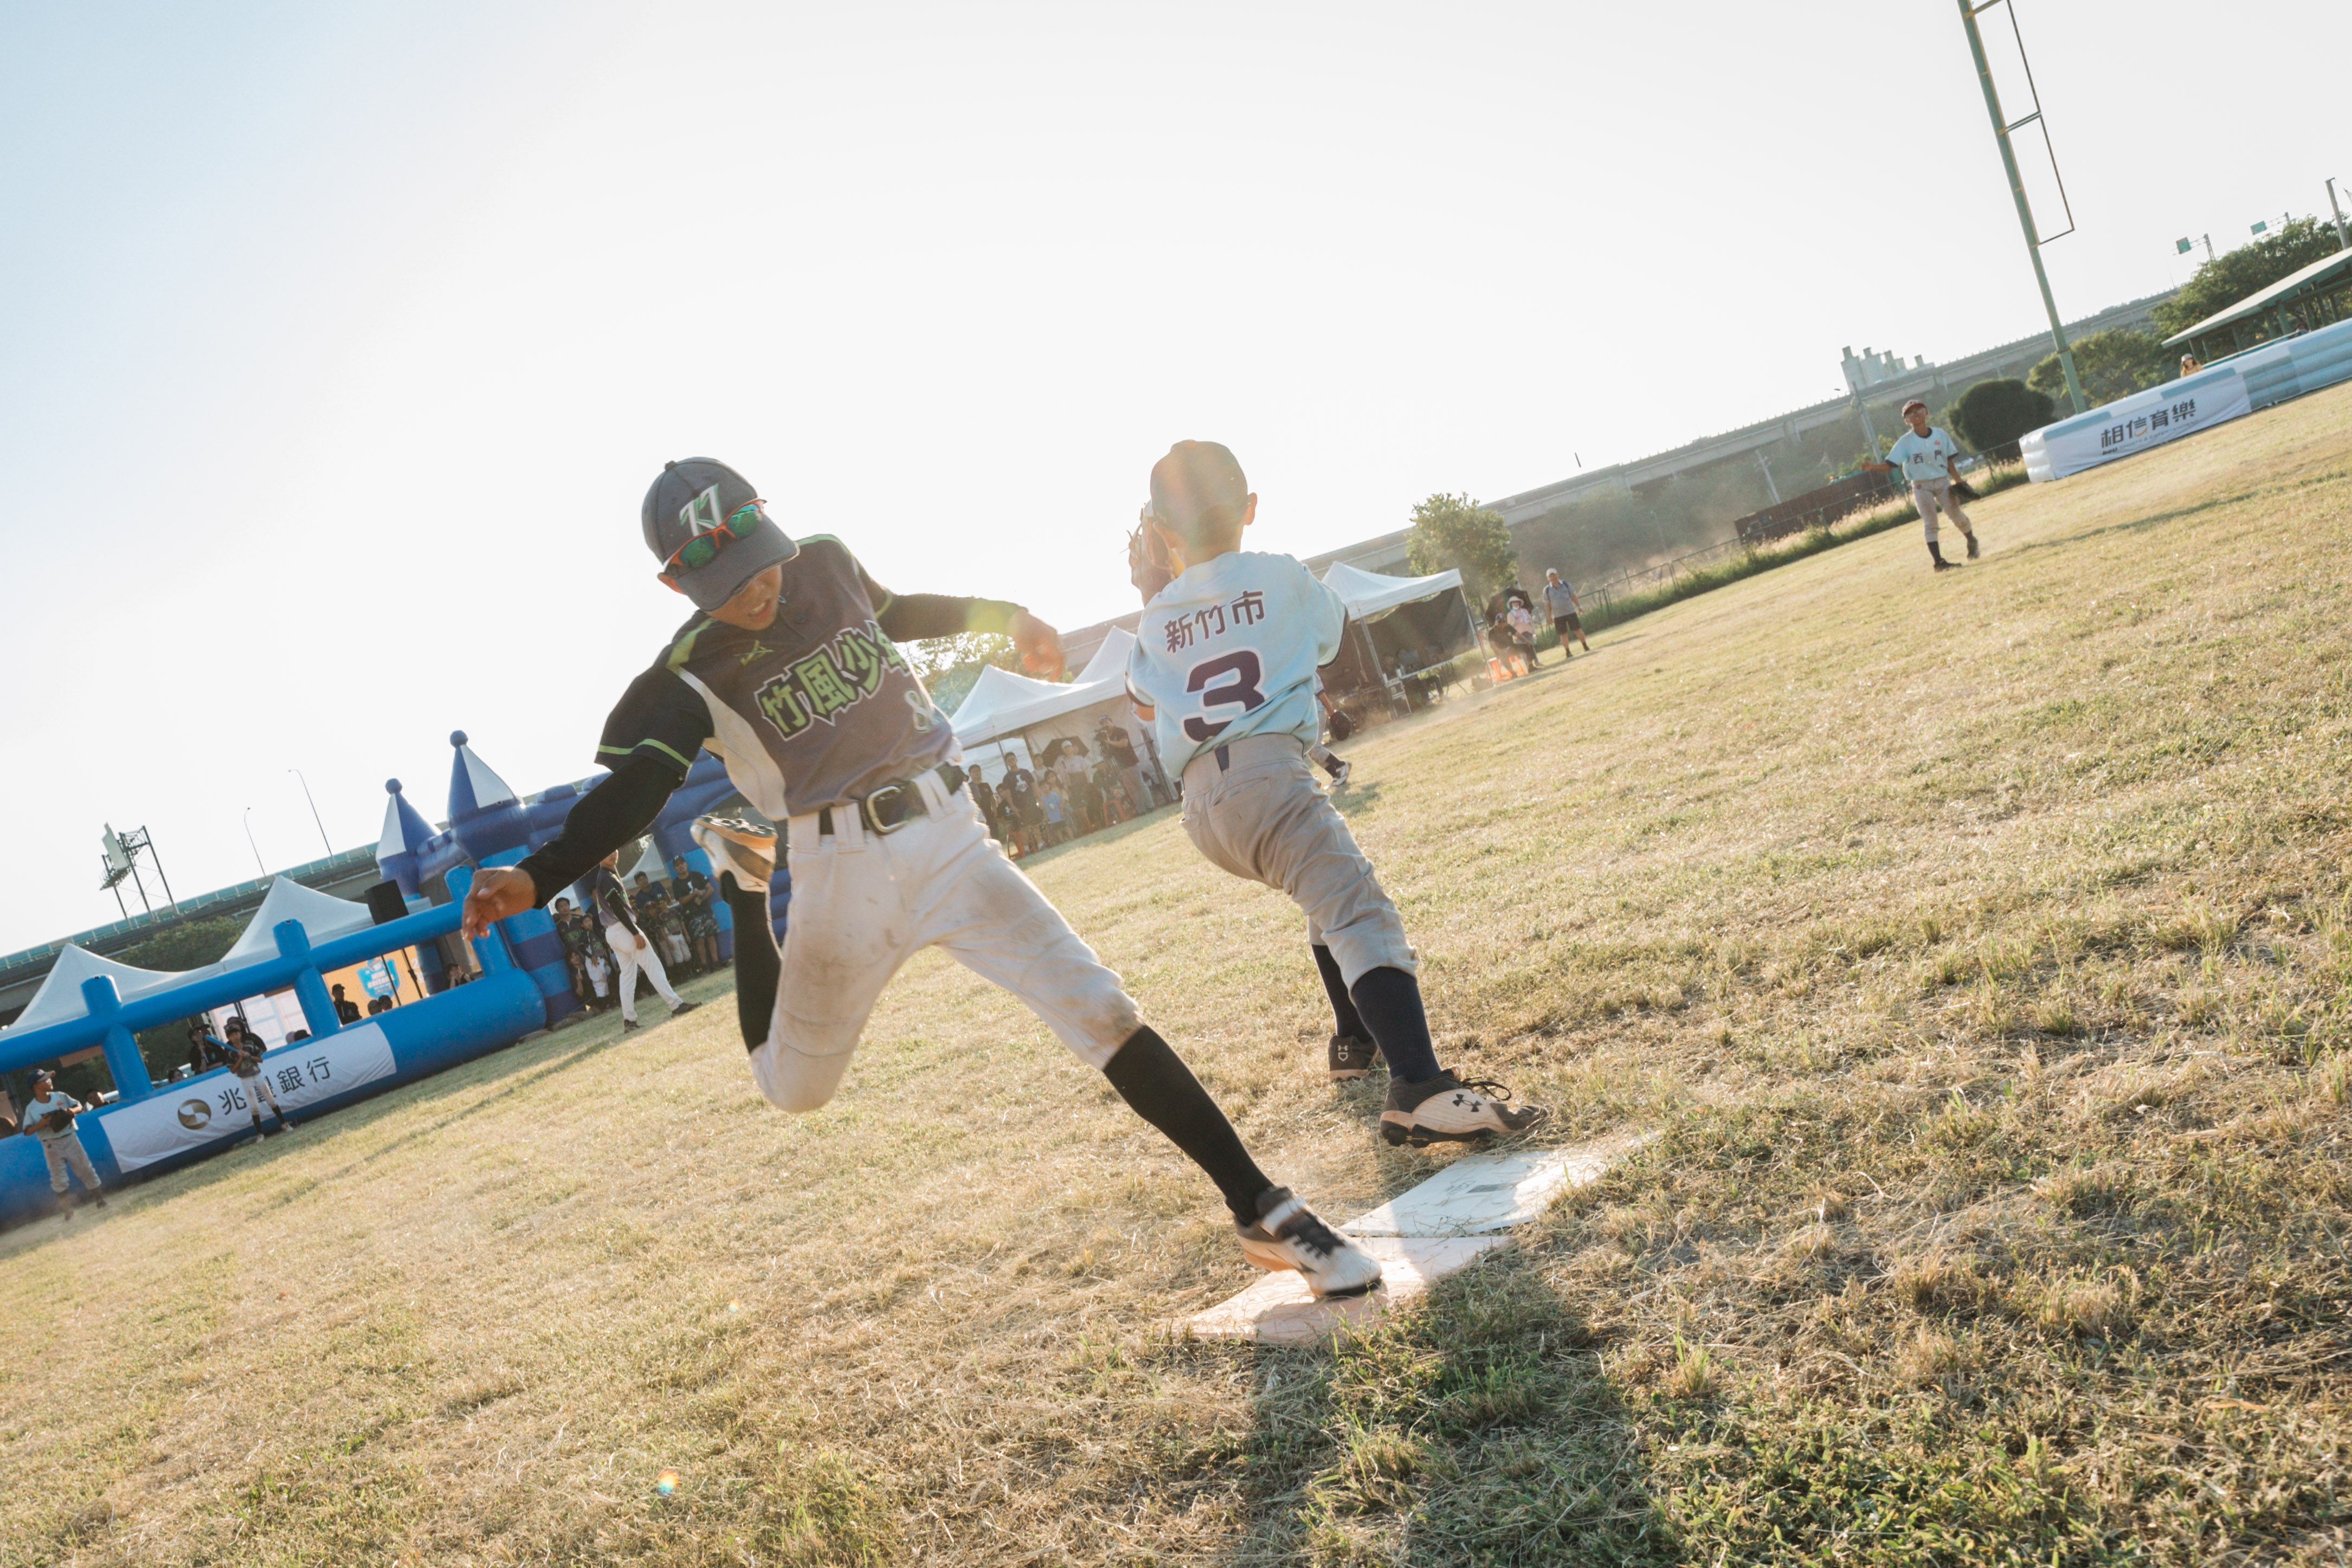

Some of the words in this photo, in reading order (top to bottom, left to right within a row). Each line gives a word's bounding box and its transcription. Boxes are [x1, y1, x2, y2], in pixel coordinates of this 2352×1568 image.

[2101, 399, 2196, 448] 相信育樂
[1164, 590, 1265, 654] 新竹市
[1182, 648, 1266, 743] 3
